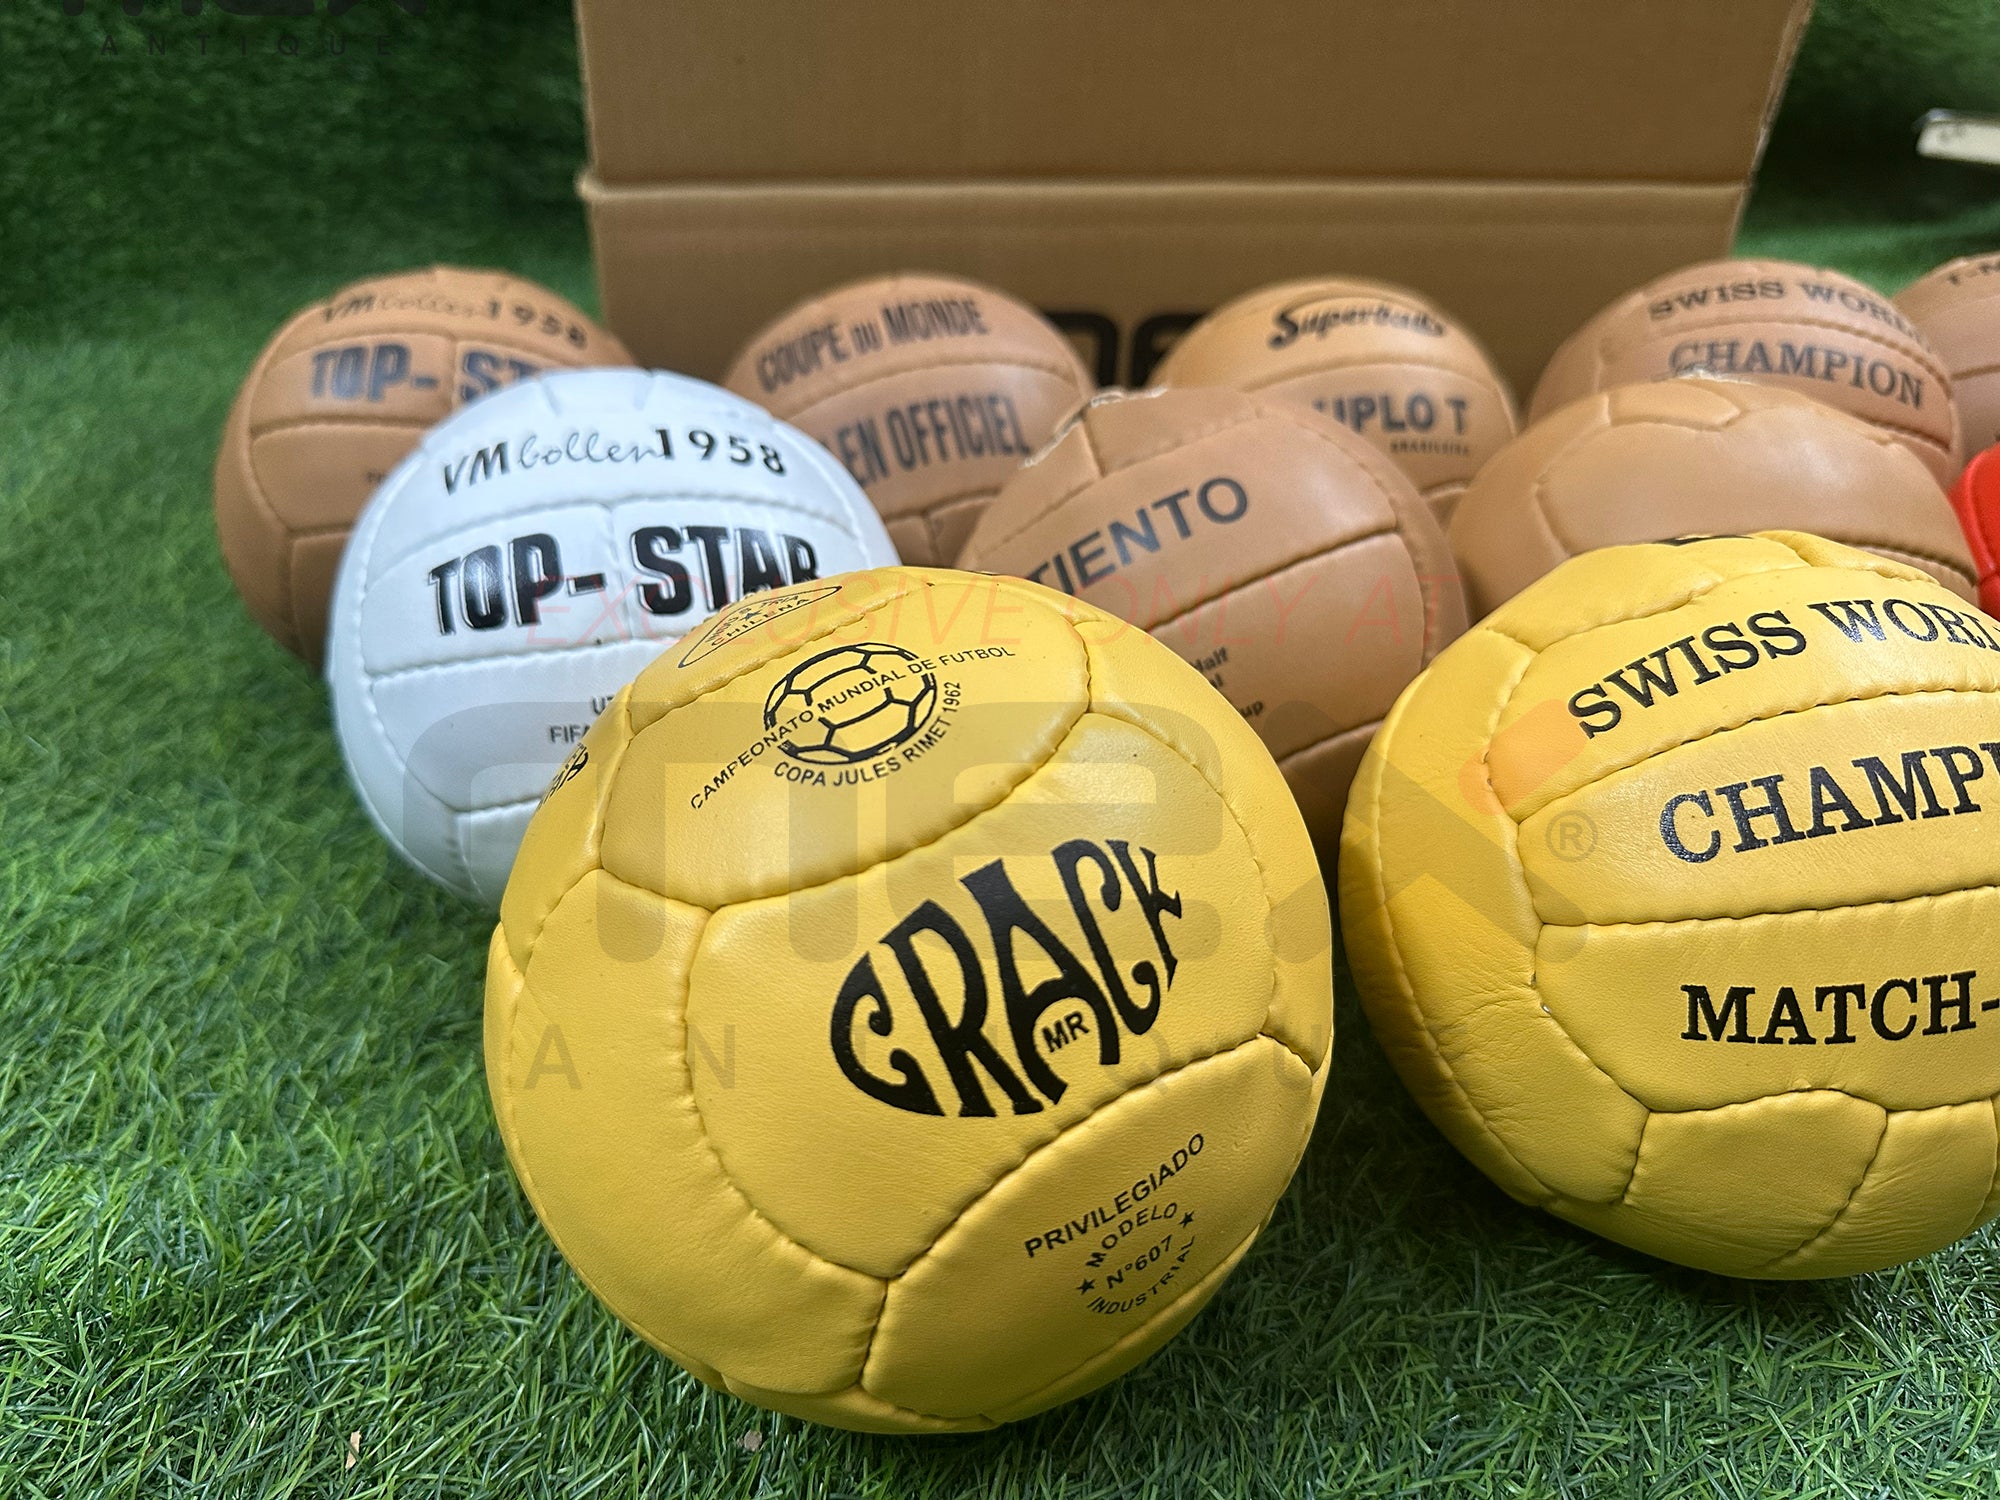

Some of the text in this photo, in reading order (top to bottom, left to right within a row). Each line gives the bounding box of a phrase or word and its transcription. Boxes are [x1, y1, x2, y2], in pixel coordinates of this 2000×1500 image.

[1648, 280, 1786, 321] SWISS
[756, 322, 849, 394] COUPE
[882, 299, 989, 344] MONDE
[1669, 339, 1924, 408] CHAMPION
[655, 427, 789, 478] 1958
[888, 393, 1031, 470] OFFICIEL
[428, 532, 607, 636] TOP-
[711, 599, 809, 645] CHILENA
[1567, 610, 1807, 739] SWISS
[690, 645, 1017, 809] CAMPEONATO MUNDIAL DE FUTBOL
[773, 680, 962, 788] COPA JULES RIMET 1962
[829, 838, 1183, 1118] CRACK
[1041, 1010, 1091, 1053] MR
[1024, 1133, 1205, 1258] PRIVILEGIADO
[1085, 1202, 1178, 1268] MODELO
[1087, 1235, 1195, 1315] INDUSTRIAL
